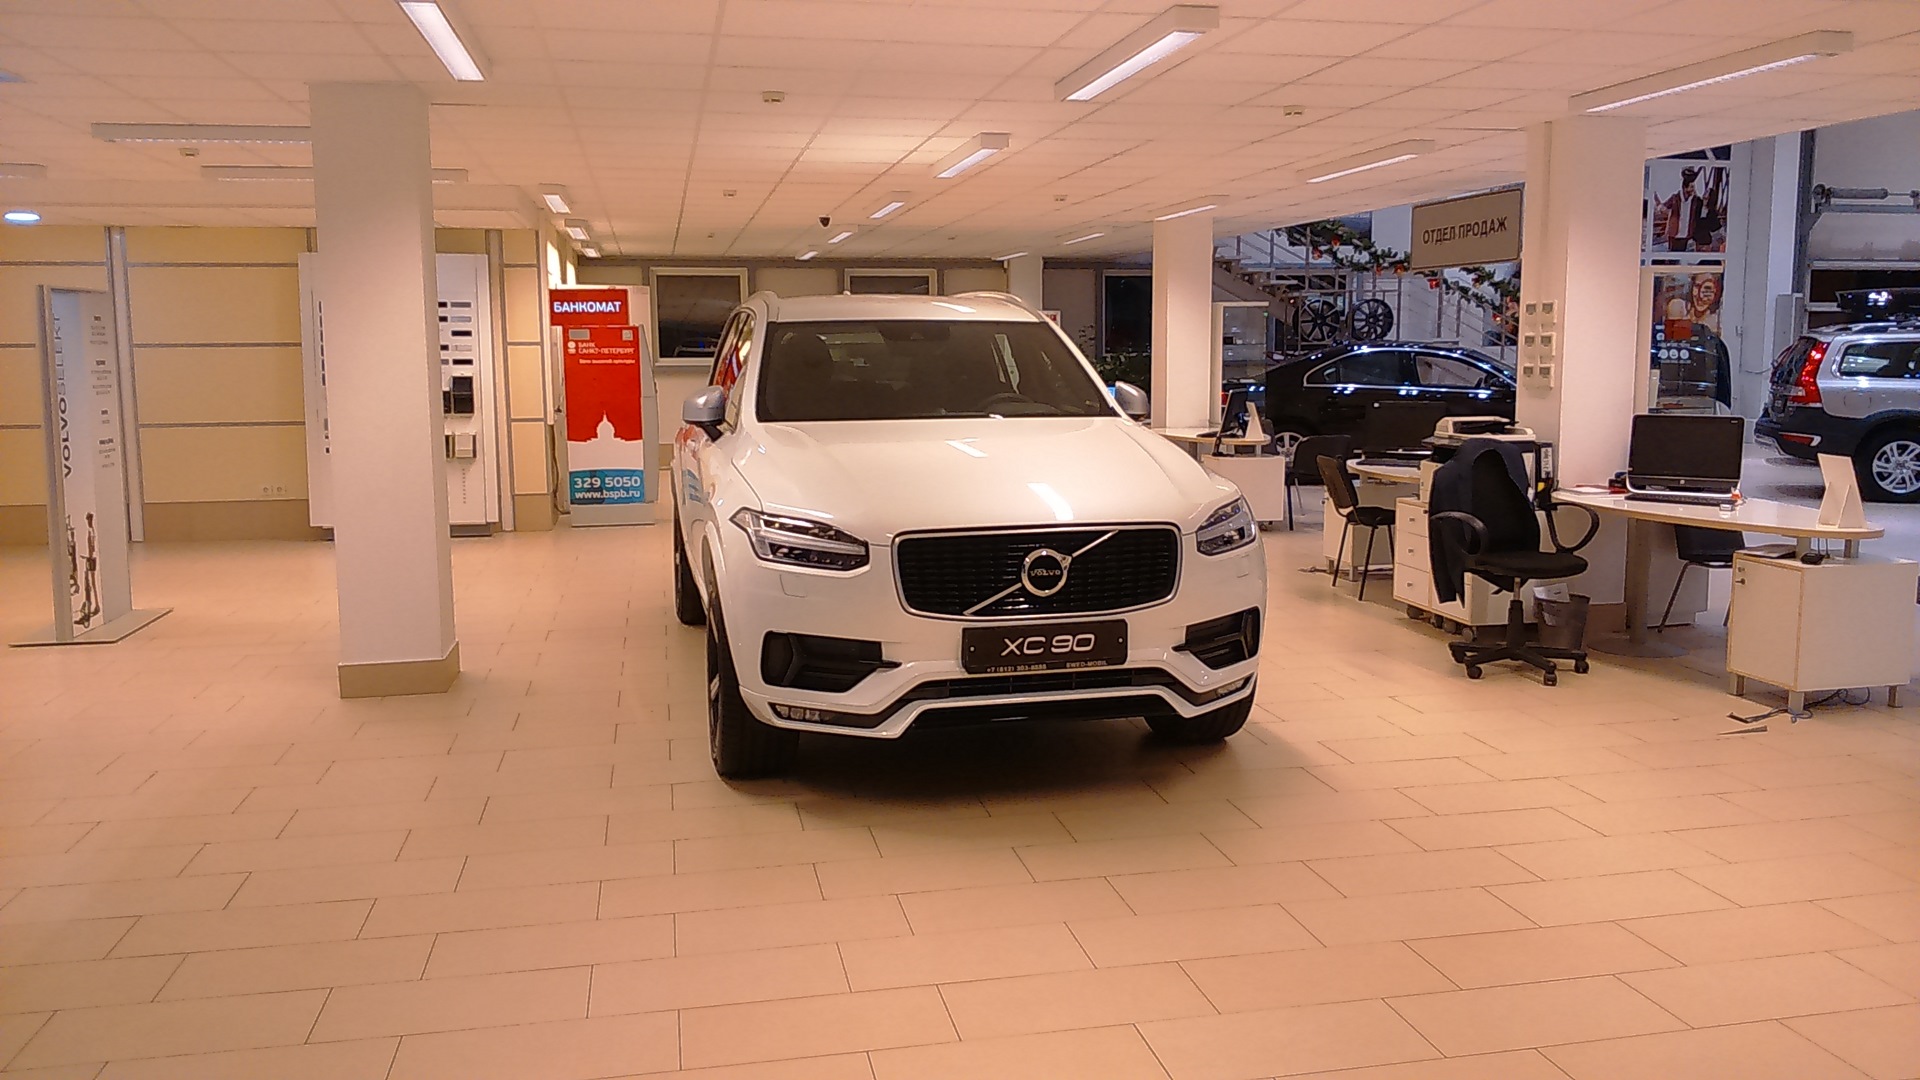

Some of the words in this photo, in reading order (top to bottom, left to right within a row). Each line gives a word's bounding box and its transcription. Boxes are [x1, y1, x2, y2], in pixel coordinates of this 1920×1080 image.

[1422, 225, 1456, 246] ОТДЕЛ
[1458, 216, 1508, 238] ПРОДАЖ
[553, 301, 622, 313] БАНКОМАТ
[574, 477, 601, 489] 329
[604, 476, 641, 488] 5050
[575, 489, 641, 500] www.bspb.ru
[1000, 636, 1047, 657] XC
[1051, 634, 1095, 653] 90
